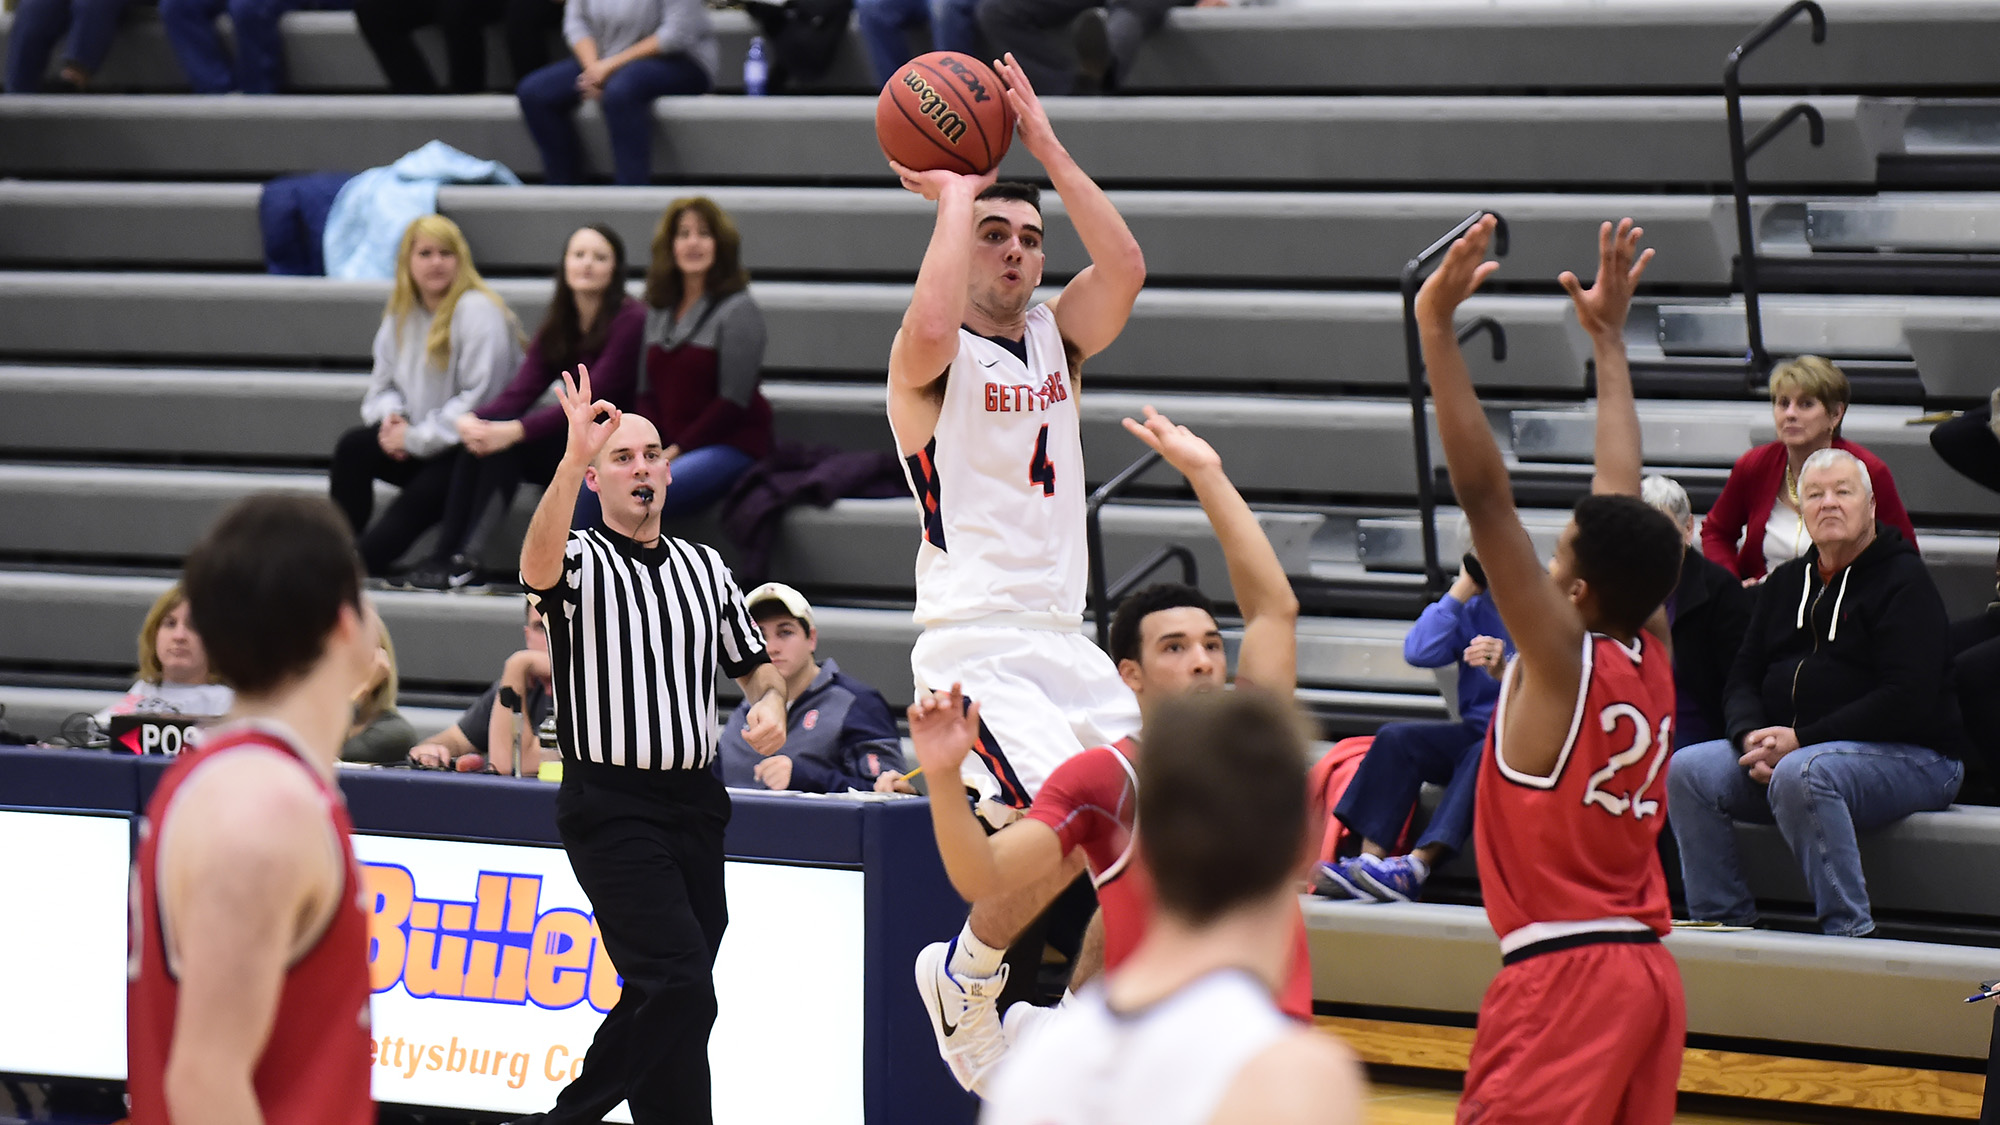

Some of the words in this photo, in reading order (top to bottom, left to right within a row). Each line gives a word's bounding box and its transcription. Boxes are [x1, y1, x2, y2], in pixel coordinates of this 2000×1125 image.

[902, 69, 968, 146] Wilson
[1029, 423, 1056, 498] 4
[142, 723, 200, 756] POS
[1583, 703, 1671, 818] 21
[358, 861, 625, 1015] Bullet
[369, 1035, 530, 1089] ettysburg
